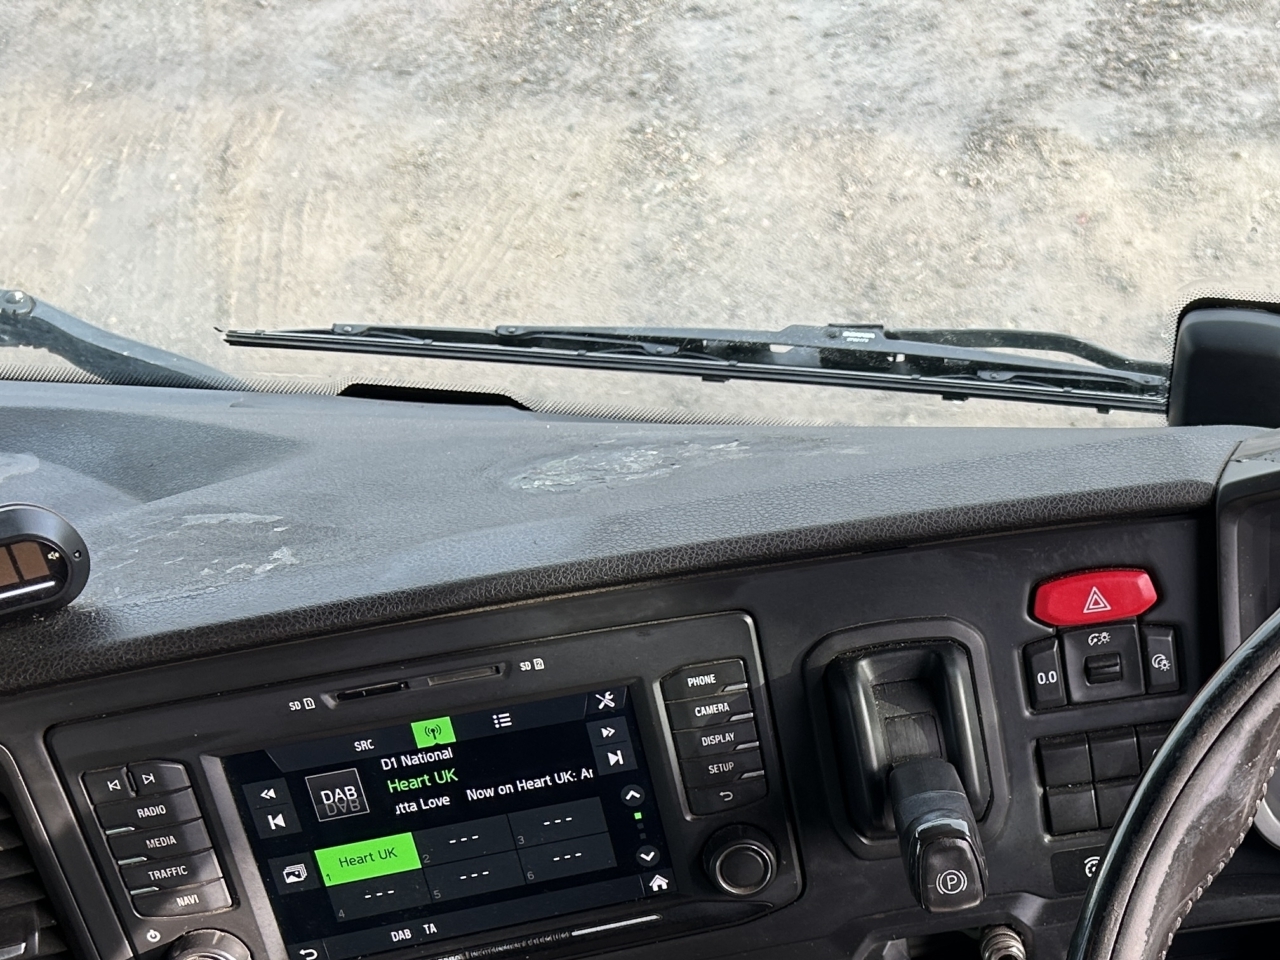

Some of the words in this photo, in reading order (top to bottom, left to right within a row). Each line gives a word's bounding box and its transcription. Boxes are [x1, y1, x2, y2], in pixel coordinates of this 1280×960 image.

[519, 661, 531, 671] SD
[687, 673, 717, 688] PHONE
[1036, 670, 1058, 685] 0.0
[288, 700, 301, 711] SD
[694, 702, 730, 717] CAMERA
[353, 739, 375, 752] SRC
[701, 732, 735, 747] DISPLAY
[380, 757, 398, 771] D1
[400, 747, 454, 768] National
[708, 761, 735, 775] SETUP
[387, 773, 432, 793] Heart
[434, 768, 459, 784] UK
[320, 785, 358, 805] DAB
[420, 795, 451, 811] Love
[466, 788, 495, 802] Now
[497, 783, 515, 796] on
[516, 774, 552, 792] Heart
[554, 770, 578, 785] UK:
[136, 804, 167, 819] RADIO
[145, 835, 177, 850] MEDIA
[517, 835, 525, 845] 3
[338, 851, 376, 868] Heart
[377, 847, 398, 861] UK
[422, 853, 431, 864] 2
[147, 865, 188, 881] TRAFFIC
[326, 873, 332, 882] 1
[527, 870, 535, 881] 6
[946, 874, 958, 890] P
[176, 894, 199, 907] NAVI
[433, 890, 442, 900] 5
[338, 908, 346, 918] 4
[390, 928, 412, 943] DAB
[422, 922, 438, 935] TA
